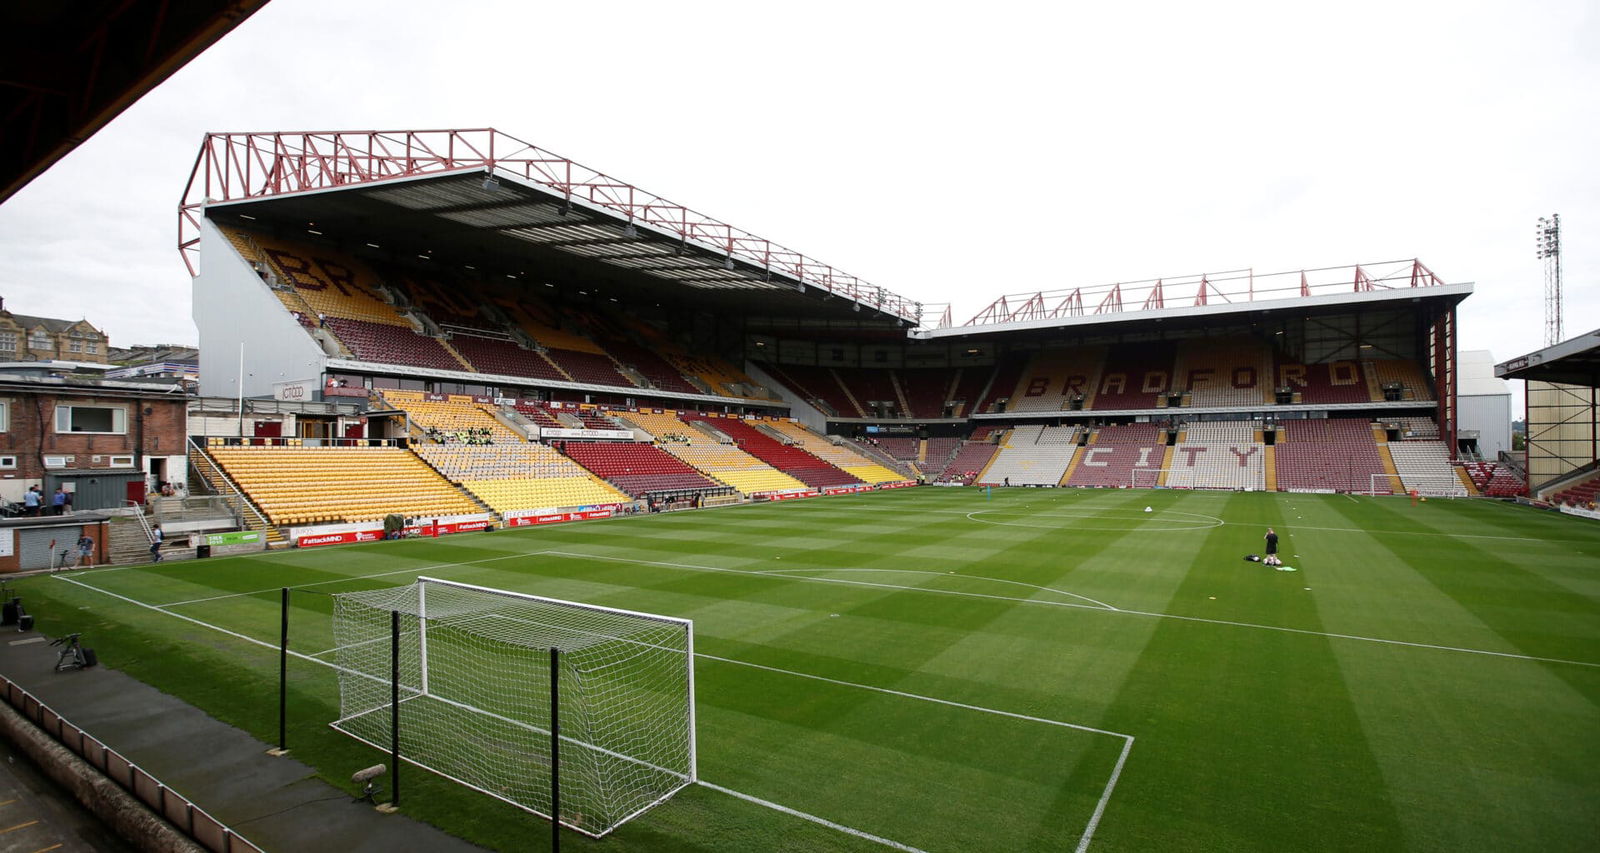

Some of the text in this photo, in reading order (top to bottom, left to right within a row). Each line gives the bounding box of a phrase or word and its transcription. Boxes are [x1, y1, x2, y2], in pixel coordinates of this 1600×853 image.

[1025, 362, 1359, 398] BRADFORD
[1084, 446, 1258, 467] CITY
[302, 535, 343, 545] #attackMND
